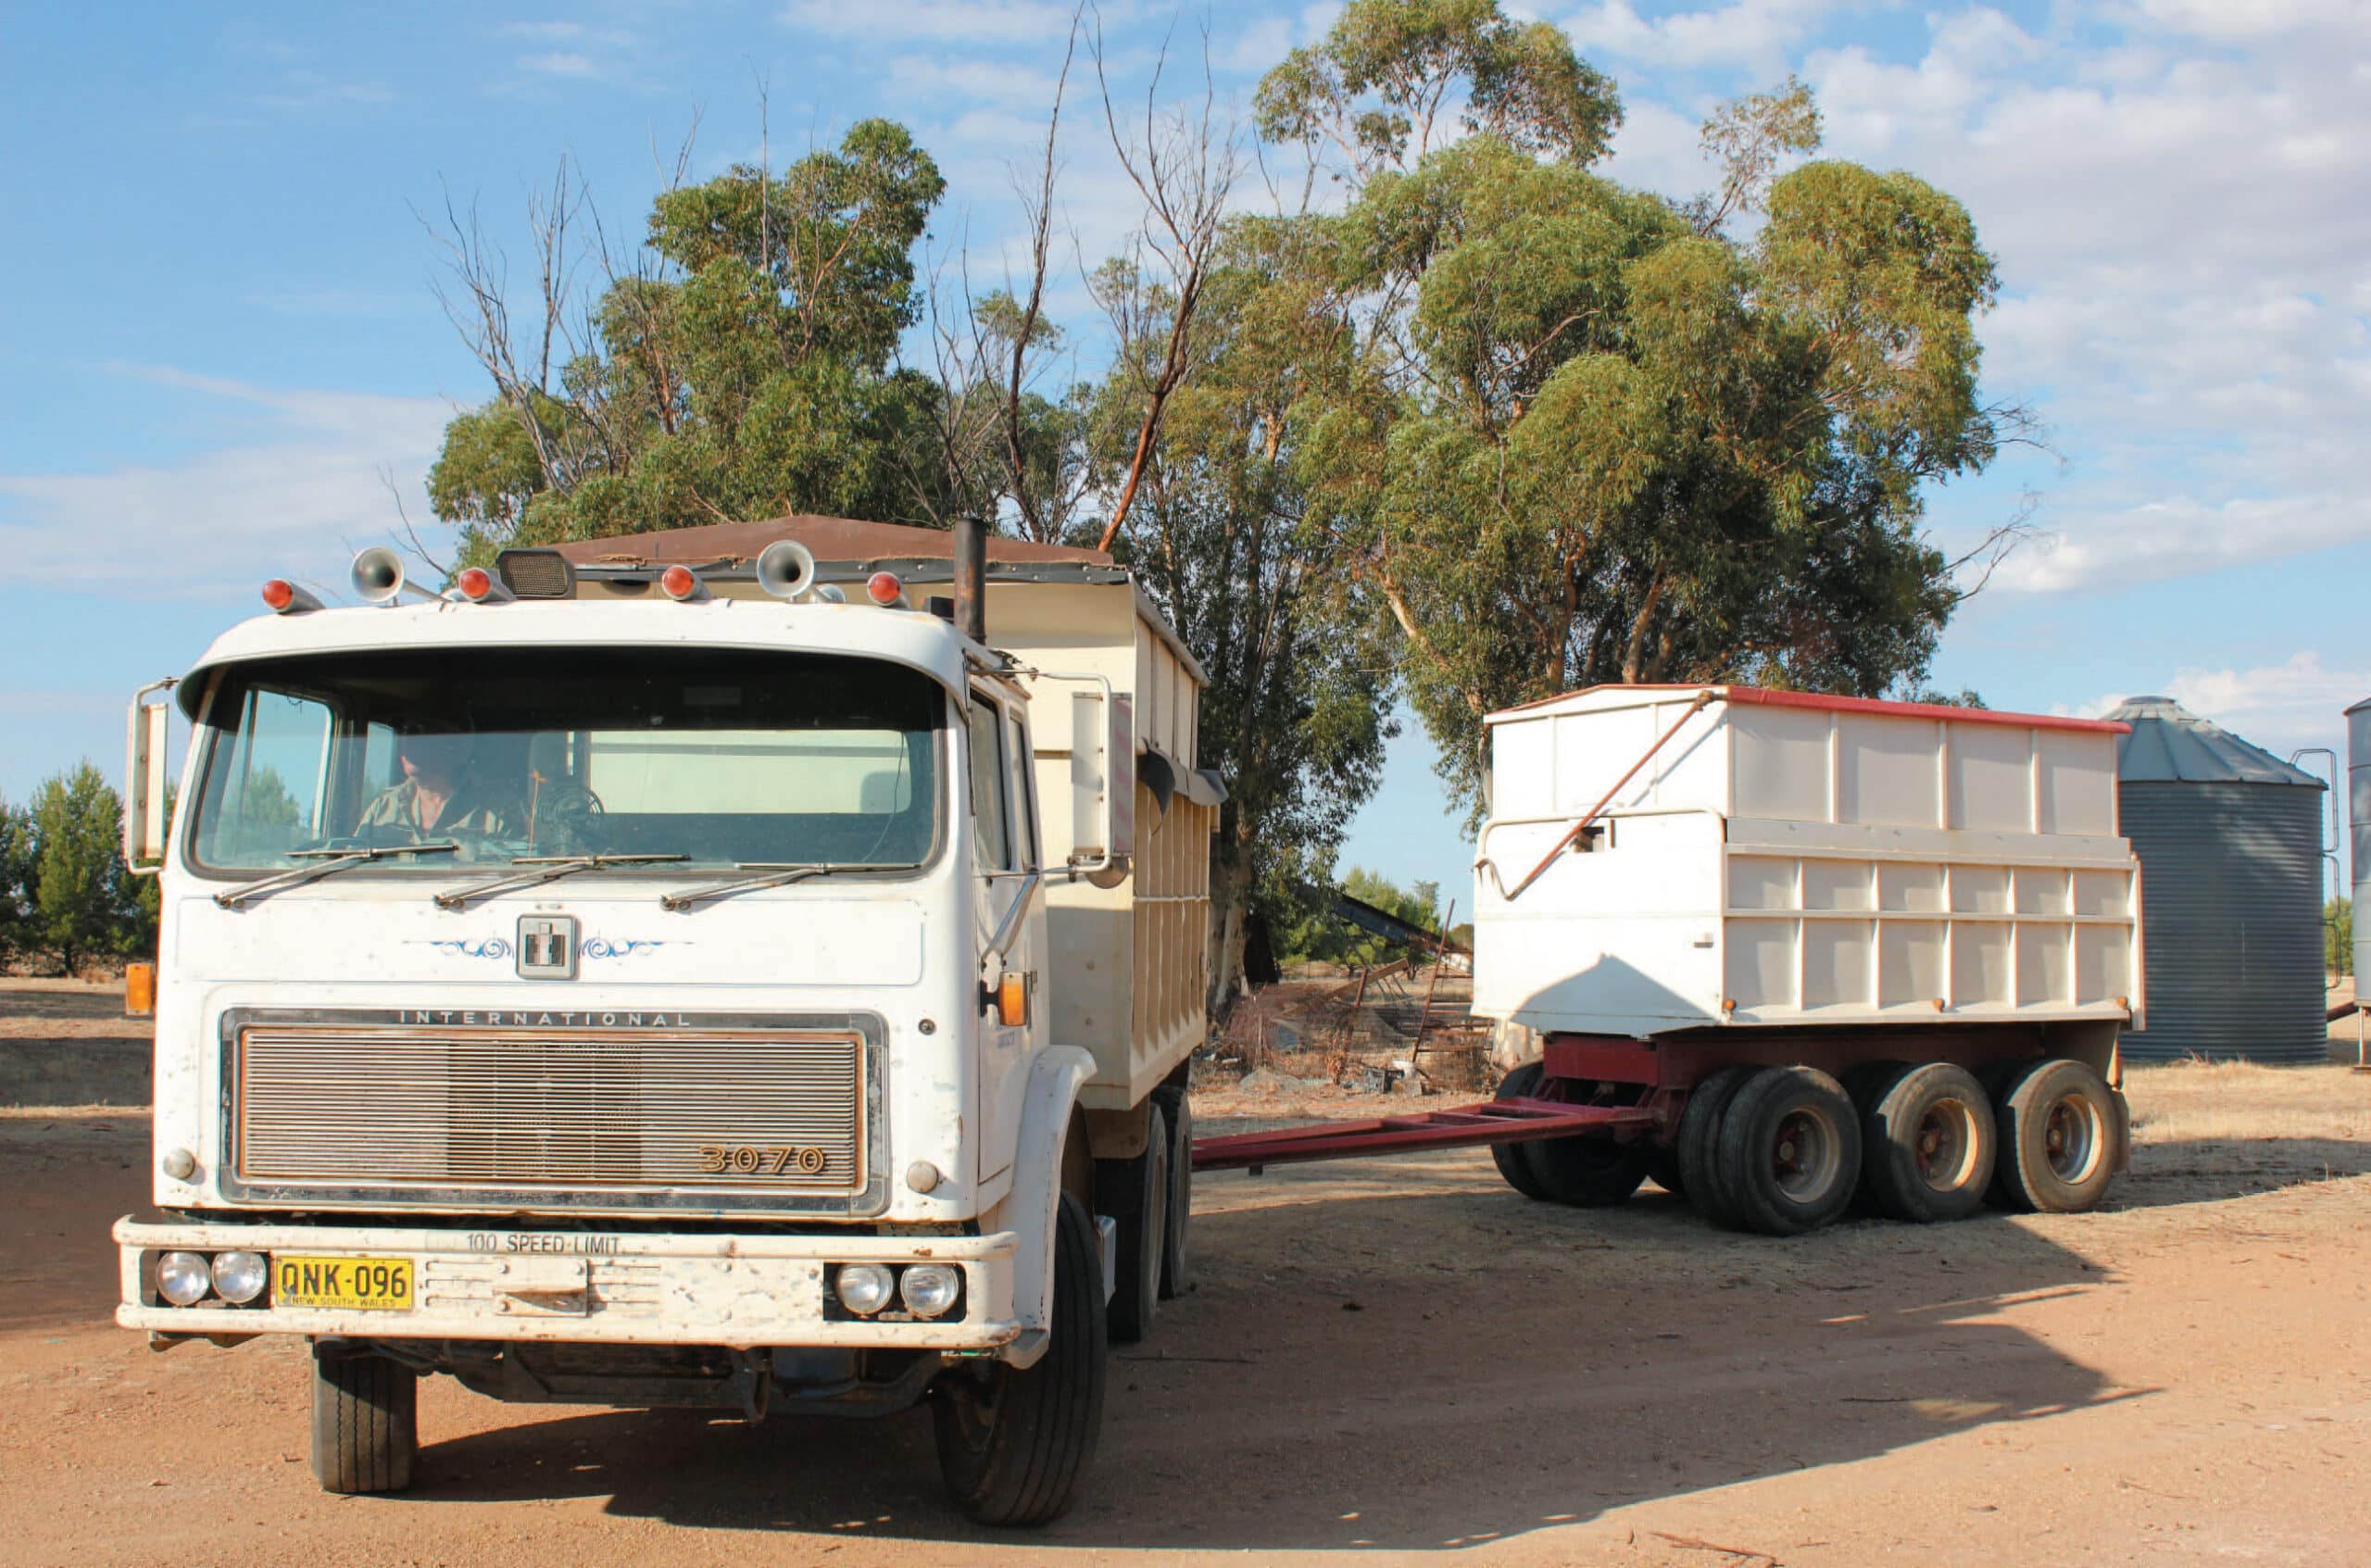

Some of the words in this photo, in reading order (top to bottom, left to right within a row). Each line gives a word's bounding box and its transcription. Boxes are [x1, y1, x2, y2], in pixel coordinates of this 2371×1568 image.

[400, 1010, 690, 1026] INTERNATIONAL
[699, 1145, 824, 1173] 3070
[468, 1233, 497, 1251] 100
[507, 1234, 564, 1253] SPEED
[574, 1236, 620, 1254] LIMIT
[320, 1298, 354, 1306] SOUTH
[360, 1298, 395, 1307] WALES
